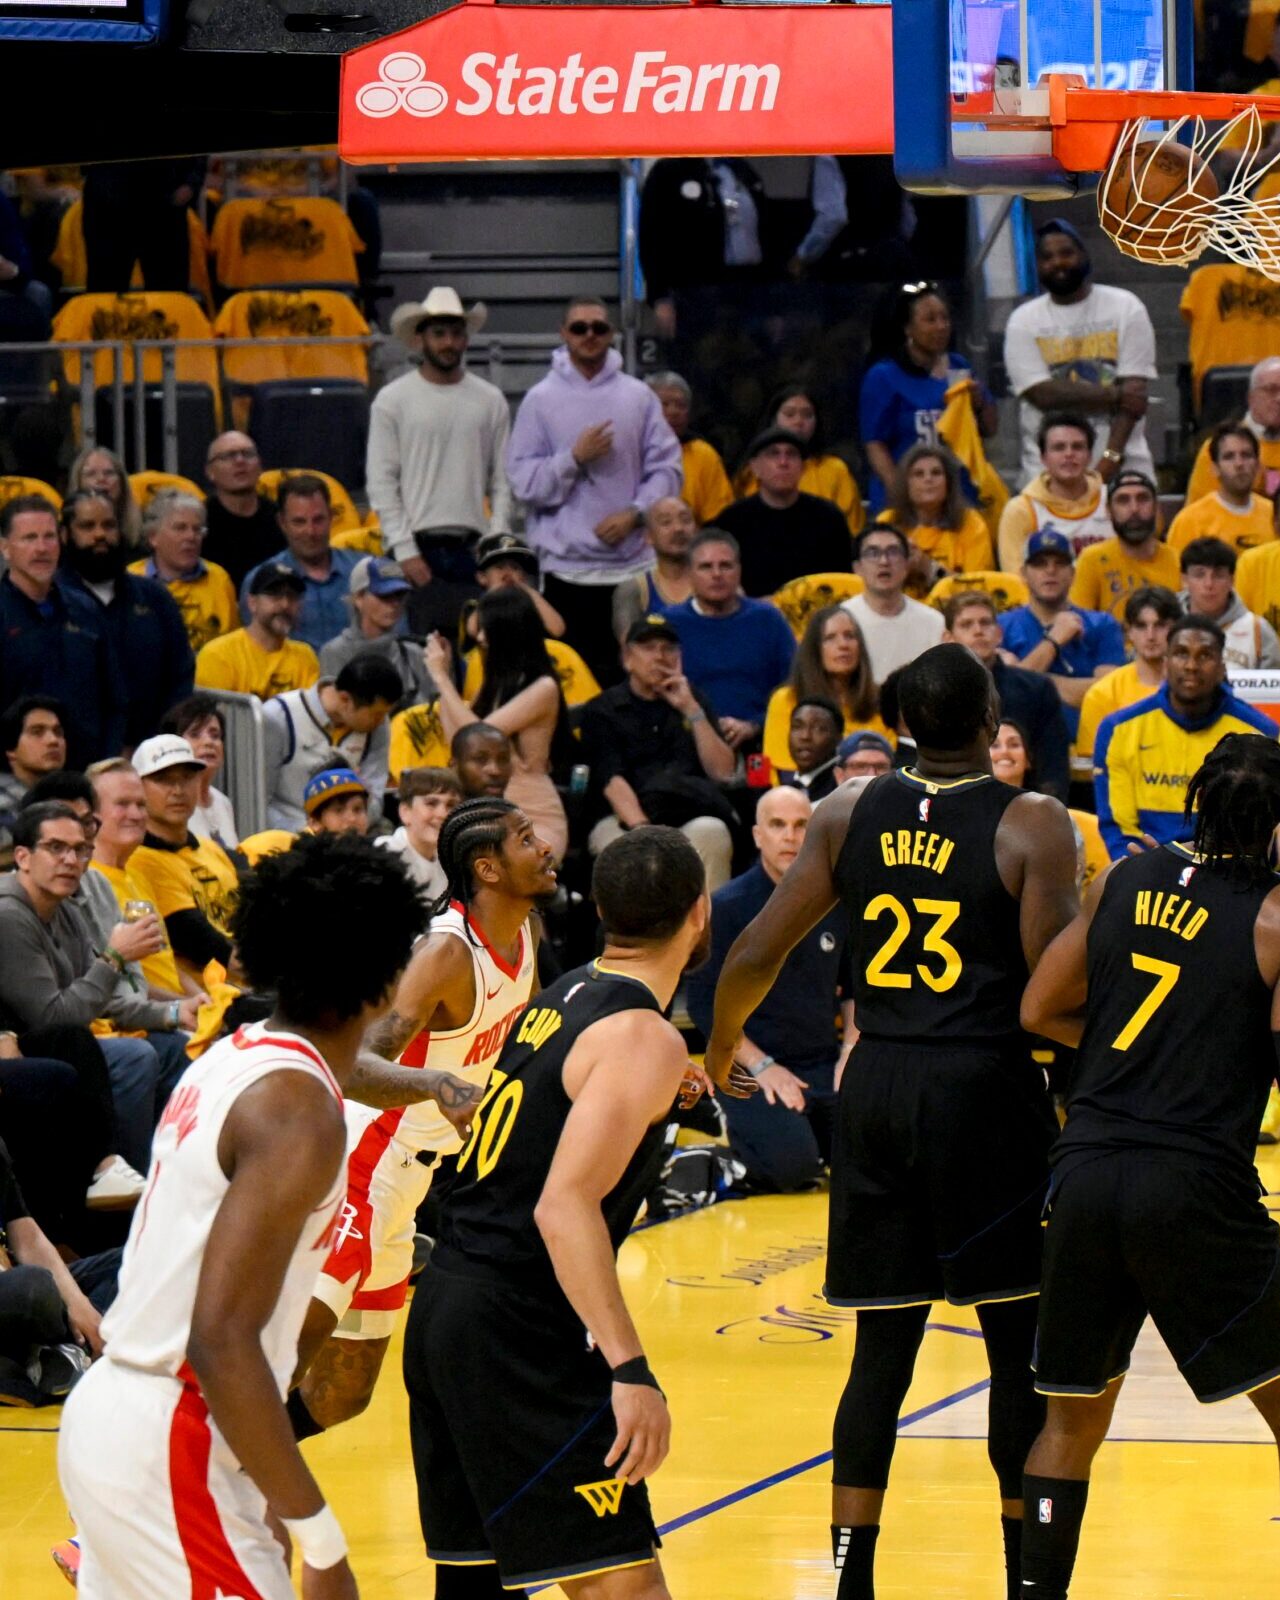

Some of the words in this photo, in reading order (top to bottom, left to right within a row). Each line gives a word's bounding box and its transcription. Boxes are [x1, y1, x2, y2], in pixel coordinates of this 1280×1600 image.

[880, 830, 955, 874] GREEN
[863, 894, 963, 993] 23
[1135, 890, 1209, 941] HIELD
[1111, 953, 1181, 1051] 7
